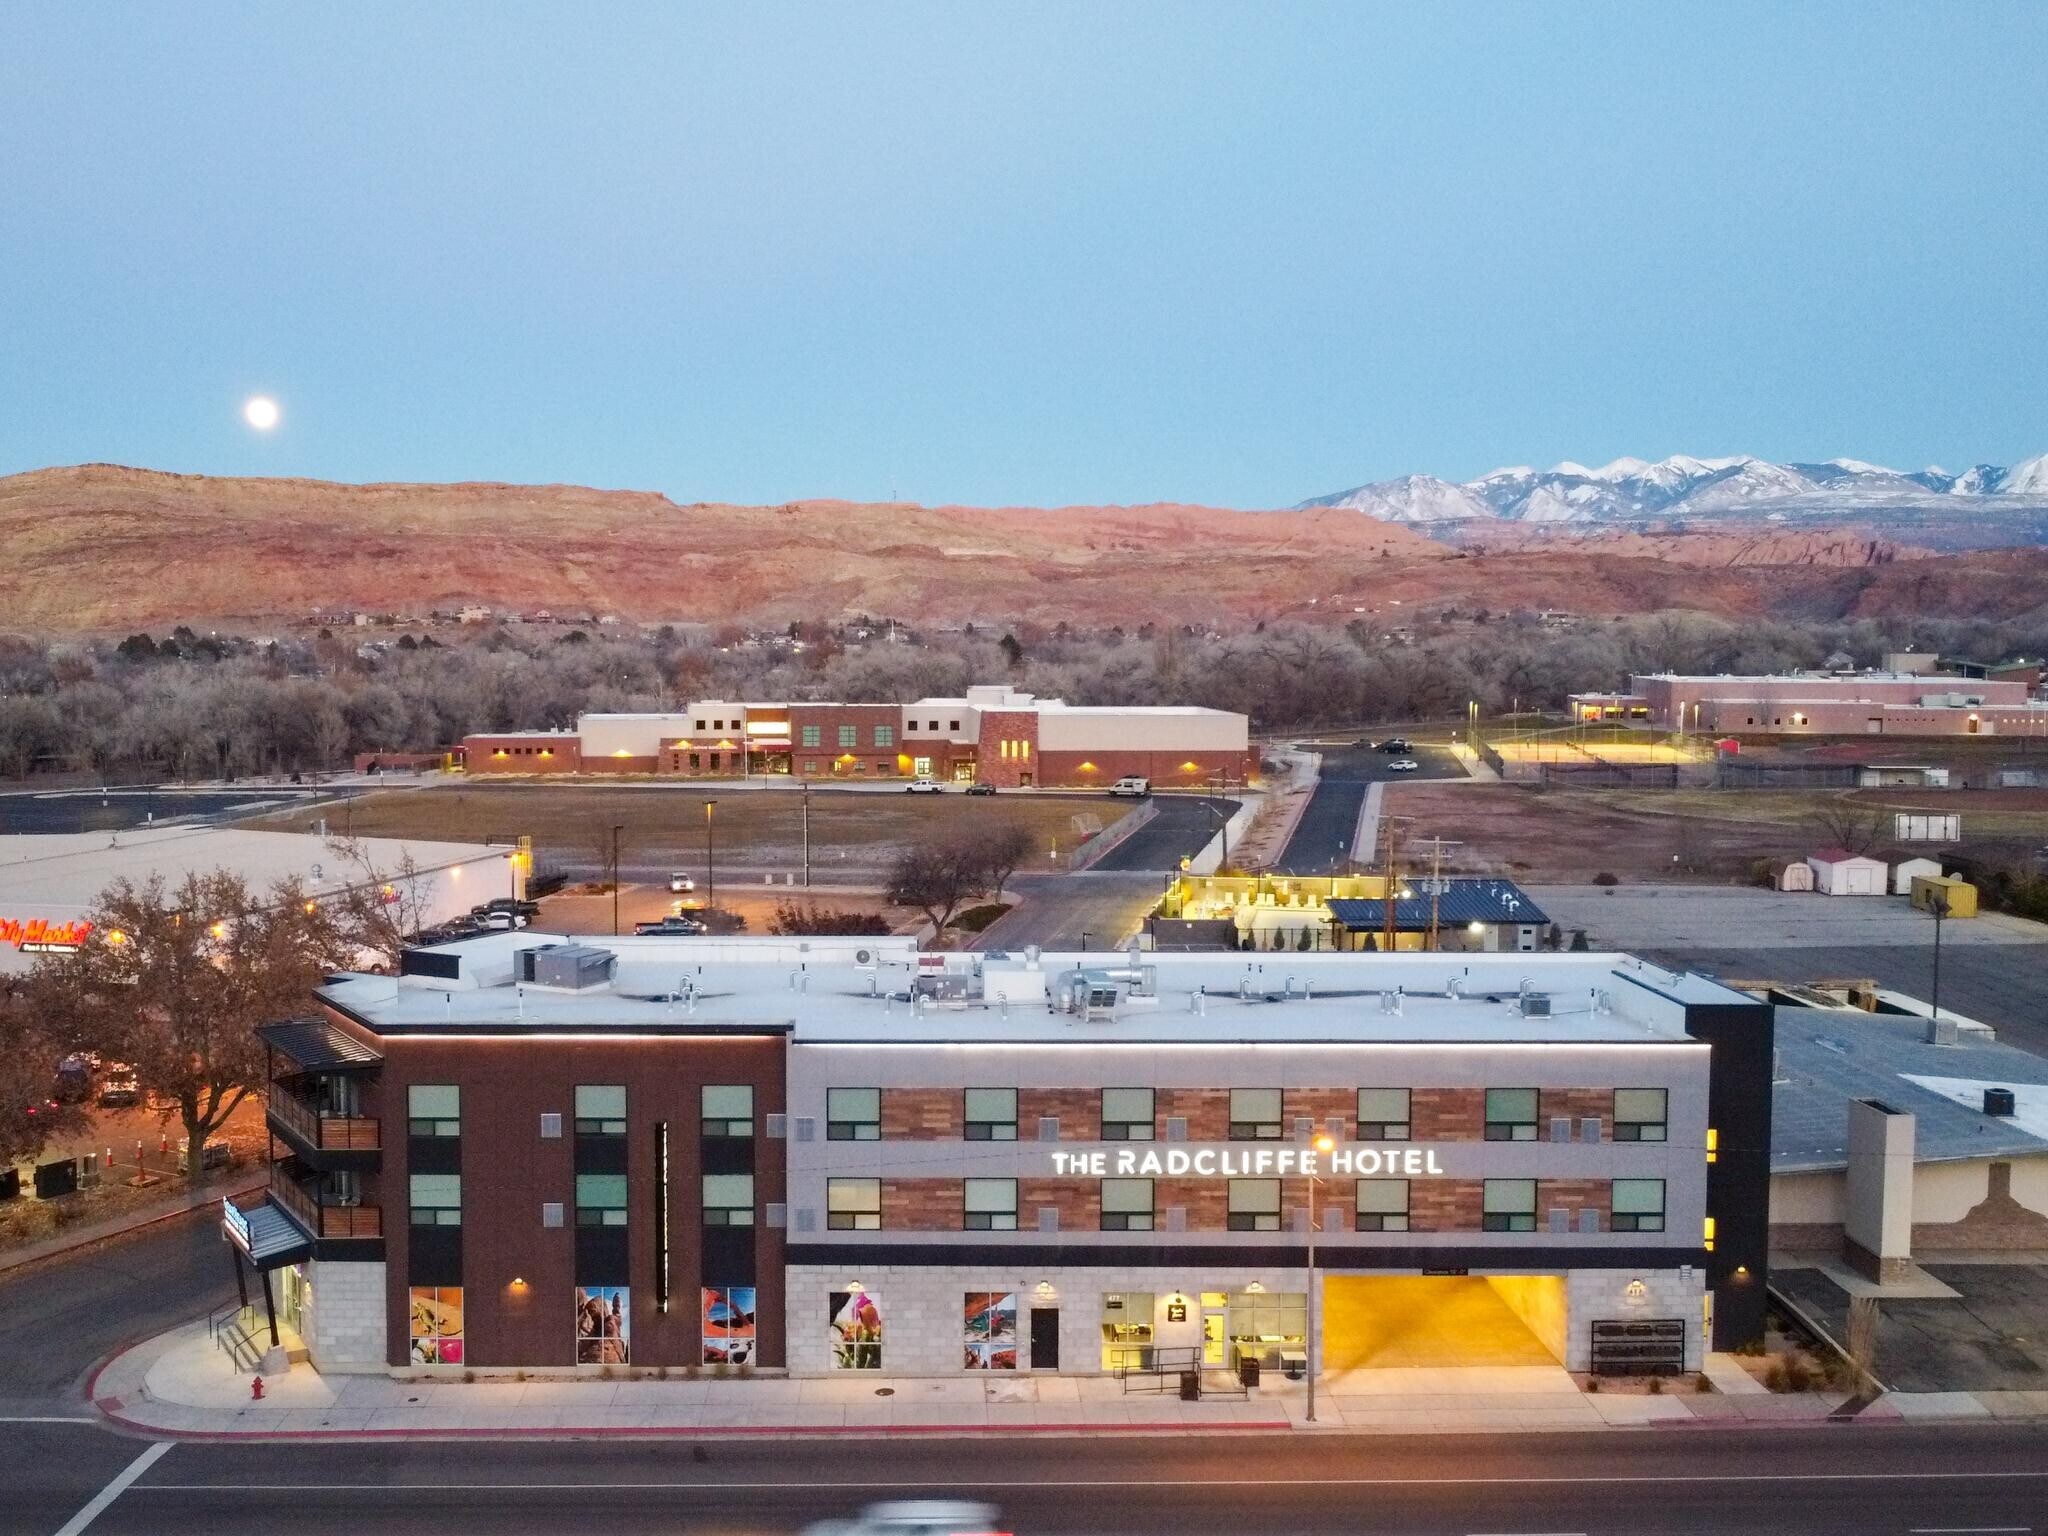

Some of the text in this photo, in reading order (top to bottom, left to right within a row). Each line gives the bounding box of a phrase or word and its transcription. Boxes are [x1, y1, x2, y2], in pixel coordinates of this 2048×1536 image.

[25, 919, 93, 943] Market
[1051, 1149, 1444, 1175] THE RADCLIFFE HOTEL
